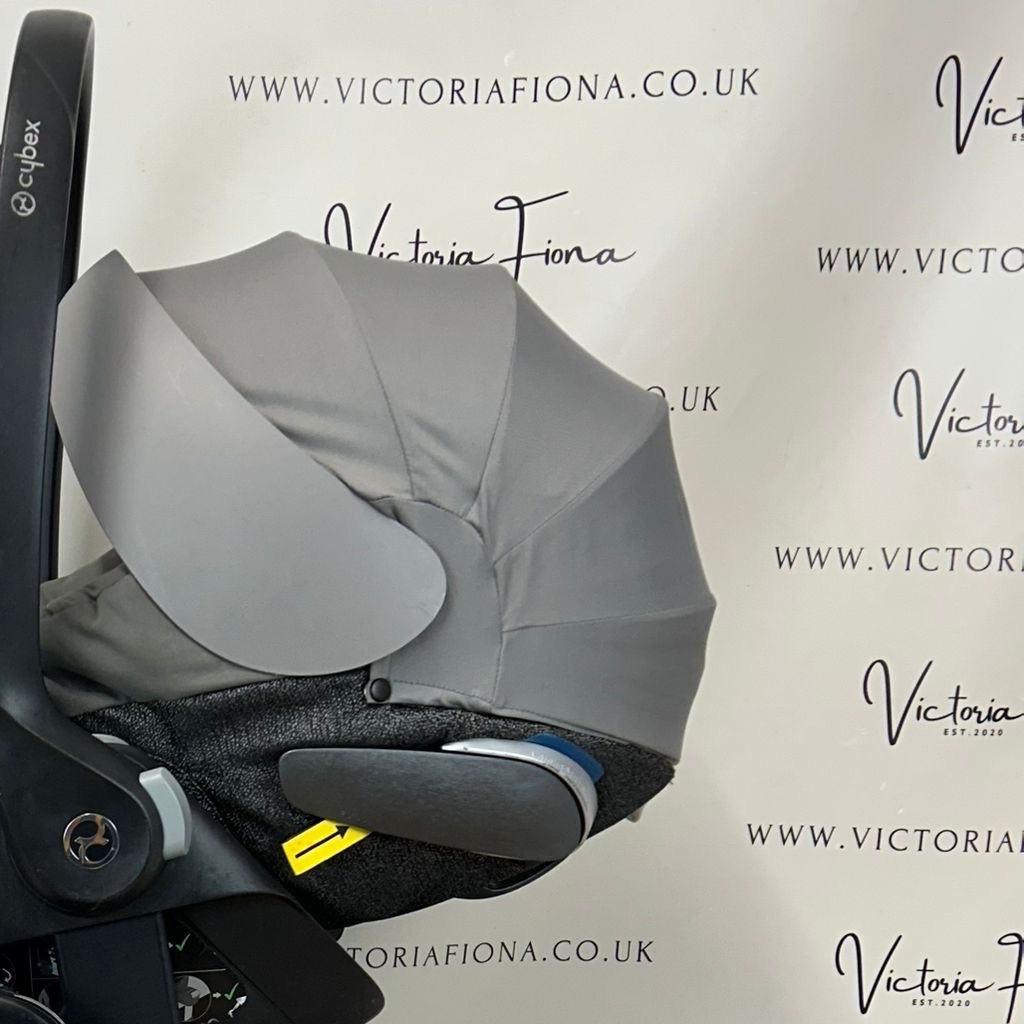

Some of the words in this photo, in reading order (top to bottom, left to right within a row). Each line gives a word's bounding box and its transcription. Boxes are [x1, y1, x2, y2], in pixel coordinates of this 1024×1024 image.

[229, 67, 760, 105] WWW.VICTORIAFIONA.CO.UK
[13, 119, 44, 187] cybex
[494, 190, 637, 282] Fiona
[863, 659, 1024, 746] Victoria
[943, 728, 1004, 737] EST.2020
[835, 932, 995, 1015] Victoria
[912, 998, 971, 1007] EST.2020
